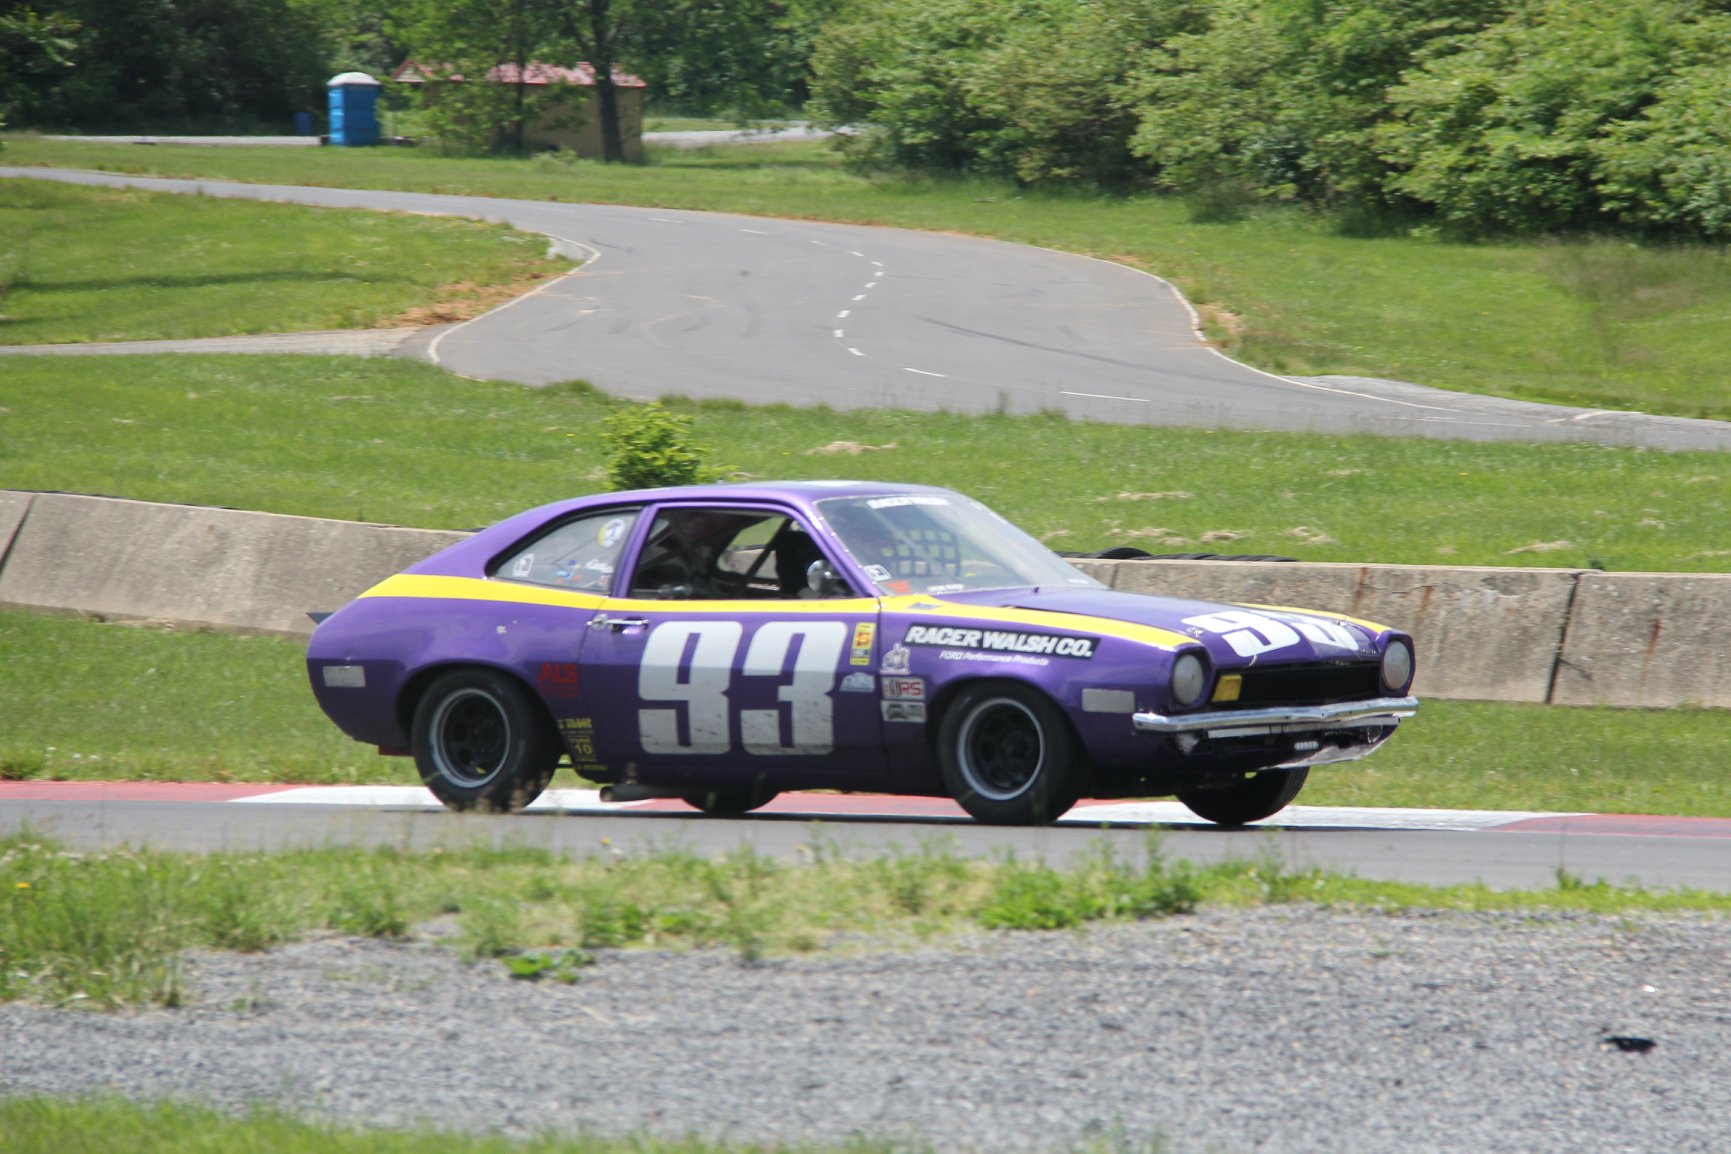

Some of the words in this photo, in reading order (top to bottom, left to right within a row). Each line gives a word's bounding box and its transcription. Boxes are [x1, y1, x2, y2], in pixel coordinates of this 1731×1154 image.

[905, 625, 983, 648] RACER
[982, 630, 1056, 654] WALSH
[1055, 636, 1093, 658] CO.
[939, 650, 963, 661] FORD
[538, 661, 578, 684] ALS
[638, 620, 848, 755] 93
